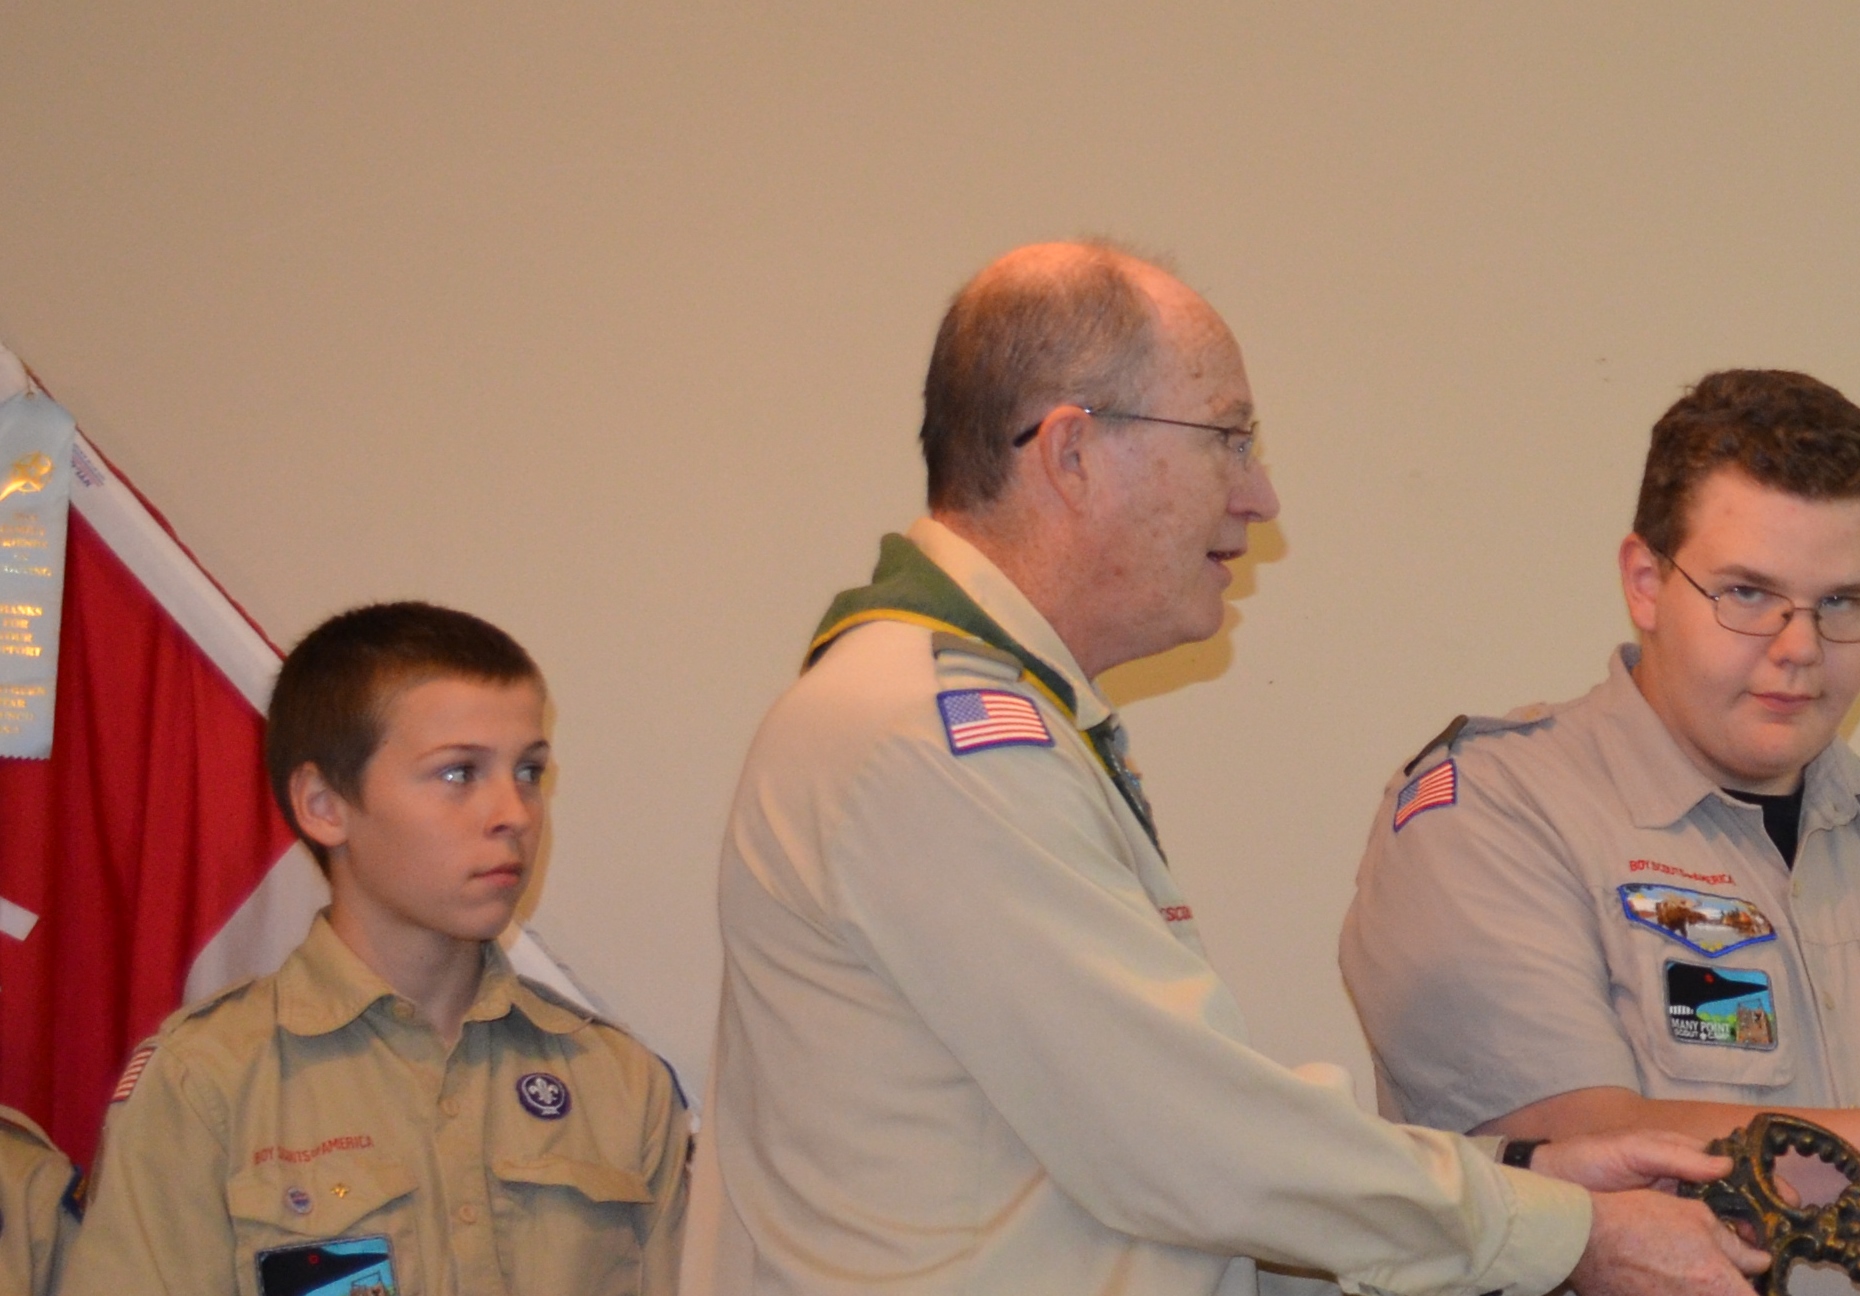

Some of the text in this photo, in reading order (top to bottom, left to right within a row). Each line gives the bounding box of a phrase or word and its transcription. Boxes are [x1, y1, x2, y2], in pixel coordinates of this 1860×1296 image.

[1671, 1018, 1732, 1033] MANY POINT
[321, 1135, 374, 1155] AMERICA
